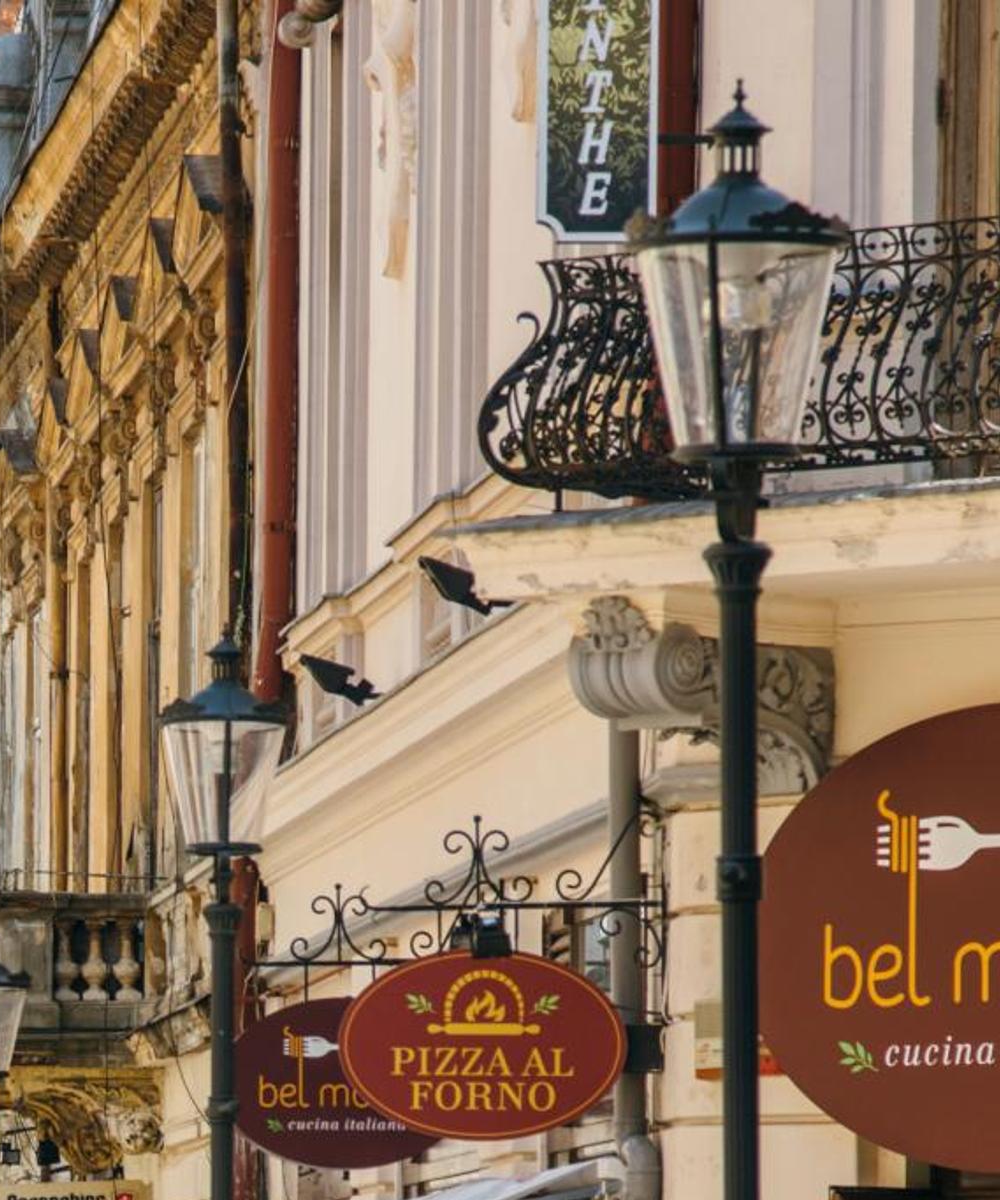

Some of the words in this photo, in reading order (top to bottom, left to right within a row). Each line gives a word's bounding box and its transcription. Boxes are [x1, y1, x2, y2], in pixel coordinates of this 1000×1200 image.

[577, 0, 616, 216] NTHE
[823, 898, 931, 1008] bel
[390, 1046, 513, 1077] PIZZA
[522, 1046, 575, 1077] AL
[884, 1035, 996, 1067] cucina
[258, 1067, 310, 1108] bel
[319, 1084, 370, 1108] mo
[409, 1081, 557, 1112] FORNO
[287, 1117, 340, 1132] cucina
